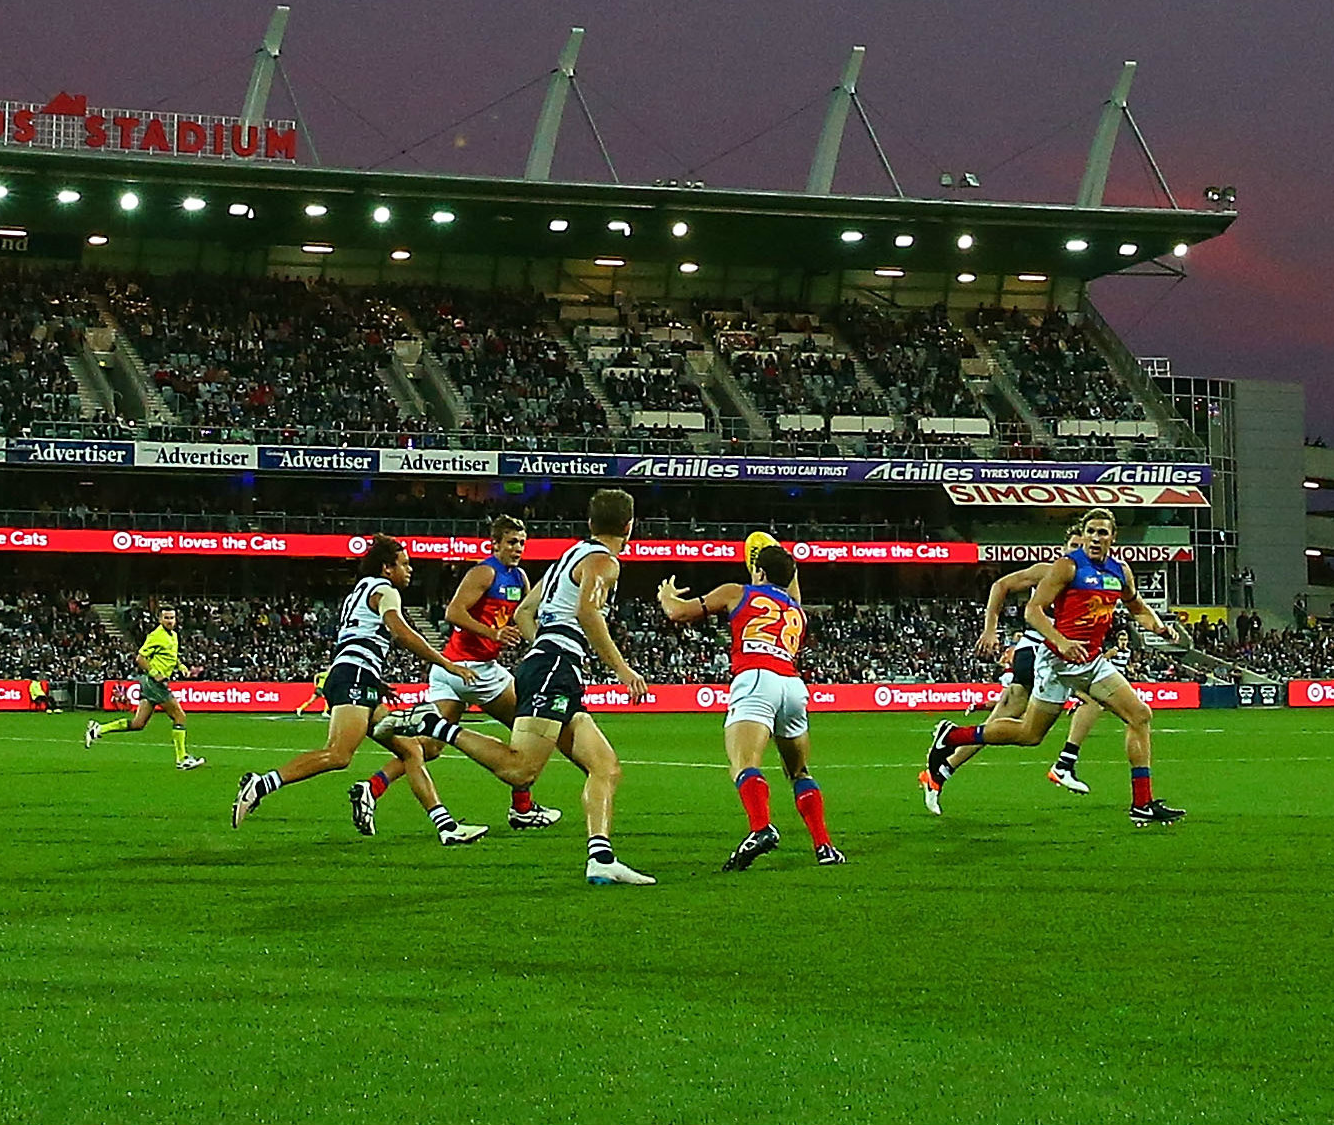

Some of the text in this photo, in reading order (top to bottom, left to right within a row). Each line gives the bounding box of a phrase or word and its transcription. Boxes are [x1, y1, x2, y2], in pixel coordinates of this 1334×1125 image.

[85, 114, 296, 159] STADIUM
[28, 442, 127, 463] Advertiser
[156, 448, 249, 467] Advertiser
[280, 451, 372, 470] Advertiser
[400, 454, 490, 472] Advertiser
[520, 456, 608, 475] Advertiser
[625, 458, 849, 478] Achilles TYRES YOU CAN TRUST
[864, 462, 1080, 482] Achilles TYRES YOU CAN TRUST
[1095, 465, 1202, 484] Achilles
[948, 485, 1146, 505] SIMONDS
[10, 531, 48, 547] Cats
[131, 534, 287, 551] Target loves the Cats
[411, 539, 449, 553] loves
[453, 540, 481, 554] the
[635, 543, 672, 556] loves
[676, 543, 700, 556] the
[702, 543, 736, 558] Cats
[810, 544, 949, 560] Target loves the Cats
[984, 546, 1063, 561] SIMONDS
[1109, 546, 1172, 561] MONDS
[741, 596, 804, 658] 28
[188, 688, 226, 703] loves
[227, 688, 251, 703] the
[256, 690, 280, 703] Cats
[605, 691, 628, 705] the
[813, 691, 835, 703] Cats
[891, 690, 927, 708] Target
[927, 690, 961, 703] loves
[961, 688, 983, 703] the
[1157, 690, 1178, 701] Cats
